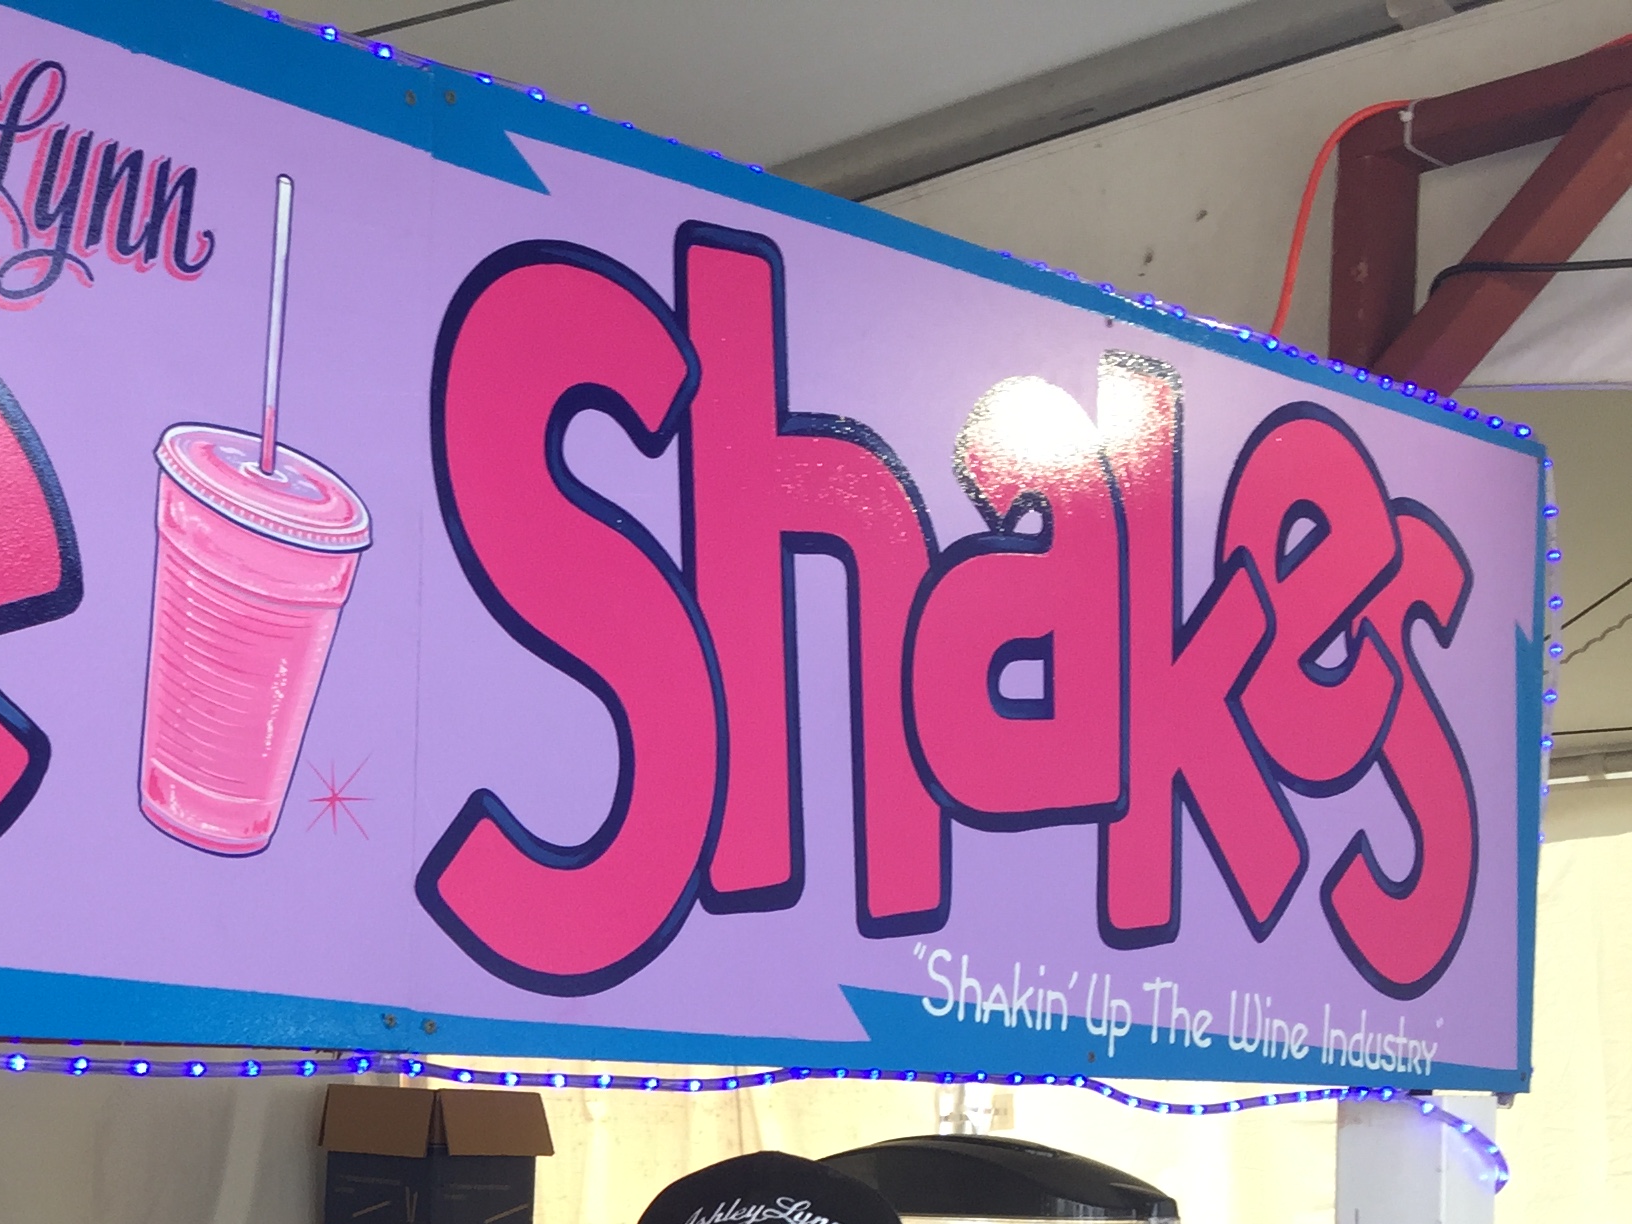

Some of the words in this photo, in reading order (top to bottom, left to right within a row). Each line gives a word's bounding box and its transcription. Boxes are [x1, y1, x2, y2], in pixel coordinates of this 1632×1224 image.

[415, 219, 1480, 1001] Shakes
[1085, 972, 1134, 1058] Up
[1142, 975, 1213, 1050] The
[1227, 988, 1311, 1060] Wine
